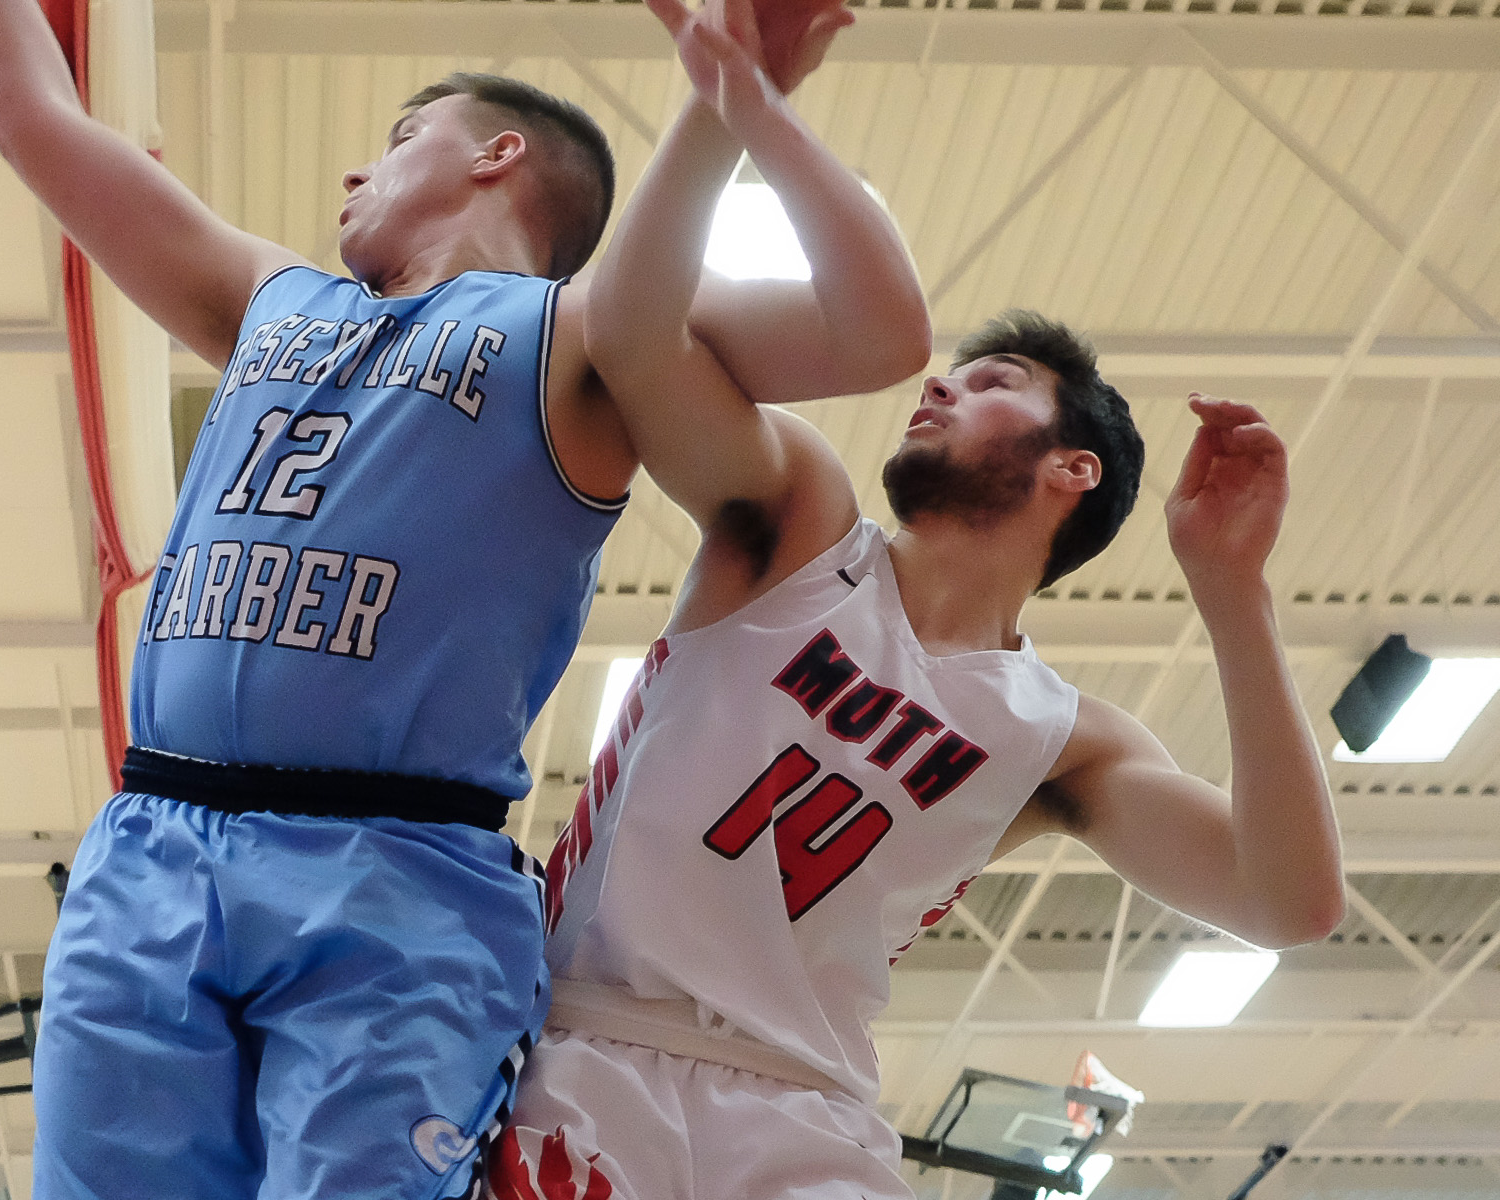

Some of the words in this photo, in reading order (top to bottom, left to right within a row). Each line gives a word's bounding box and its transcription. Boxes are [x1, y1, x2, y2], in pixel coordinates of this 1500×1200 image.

[215, 406, 353, 520] 12
[770, 627, 990, 812] MUTH
[702, 742, 893, 922] 14
